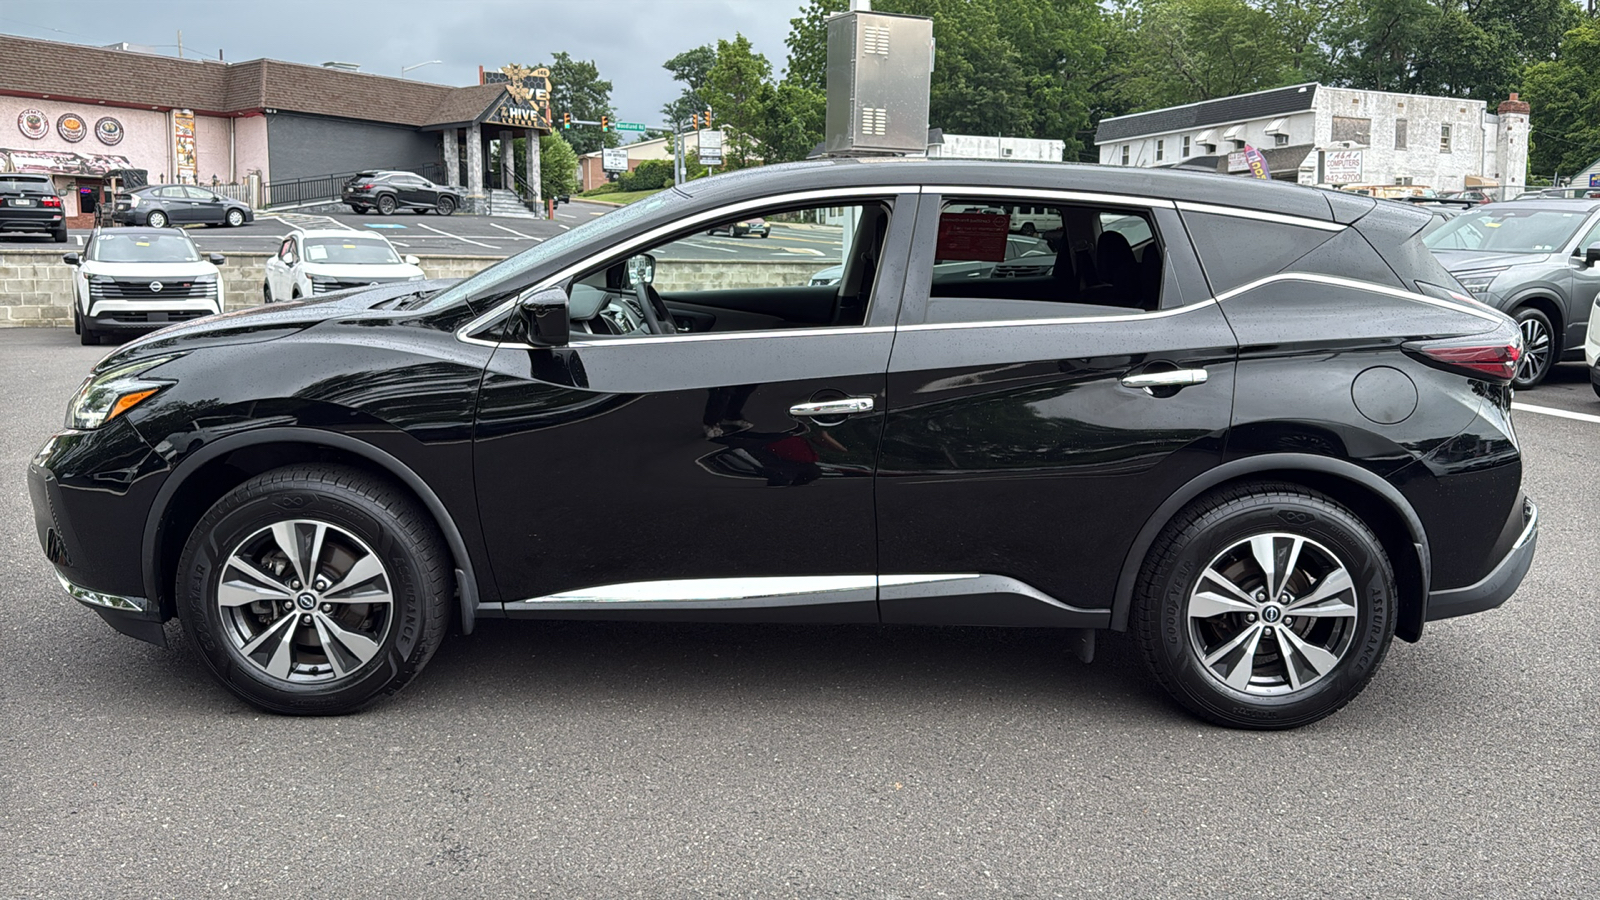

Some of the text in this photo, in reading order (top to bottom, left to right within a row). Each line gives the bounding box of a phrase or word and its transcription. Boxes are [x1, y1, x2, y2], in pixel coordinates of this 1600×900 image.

[509, 107, 539, 121] HIVE
[501, 117, 538, 127] LOUNGE
[1326, 159, 1360, 167] COMPUTERS
[1325, 173, 1361, 182] 942-9700
[392, 556, 417, 645] ASSURANCE
[1165, 560, 1194, 645] GOODYEAR
[1355, 587, 1384, 672] ASSURANCE
